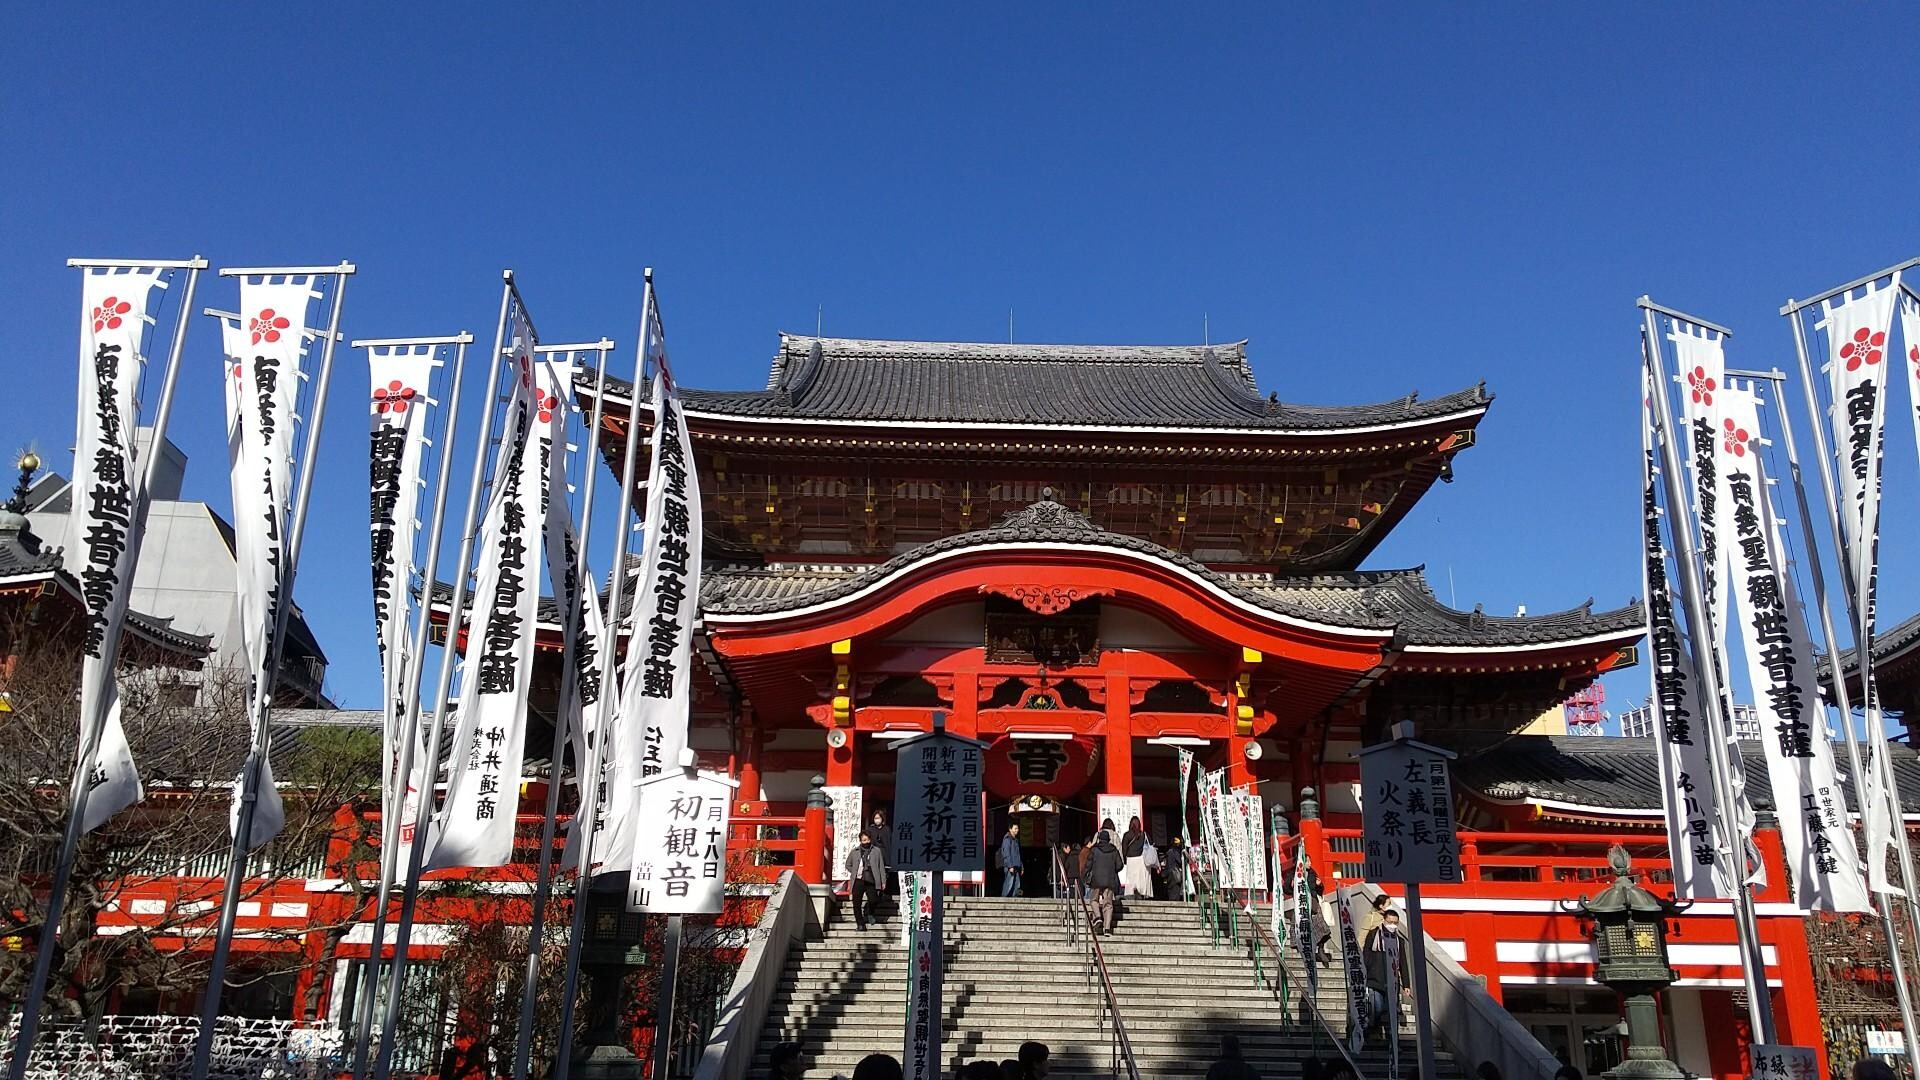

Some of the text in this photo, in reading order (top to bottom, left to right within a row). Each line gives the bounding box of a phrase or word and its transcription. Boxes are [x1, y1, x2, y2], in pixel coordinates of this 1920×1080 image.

[1726, 466, 1816, 758] 南無聖観世音菩薩
[921, 746, 938, 775] 開運
[940, 745, 956, 774] 新年
[962, 748, 978, 777] 正月
[1007, 739, 1070, 784] 音
[920, 776, 957, 865] 初祈祷
[1379, 779, 1405, 868] 火祭り
[1404, 758, 1434, 845] 左義長
[1818, 787, 1839, 828] 四世家元
[660, 790, 703, 897] 初観音
